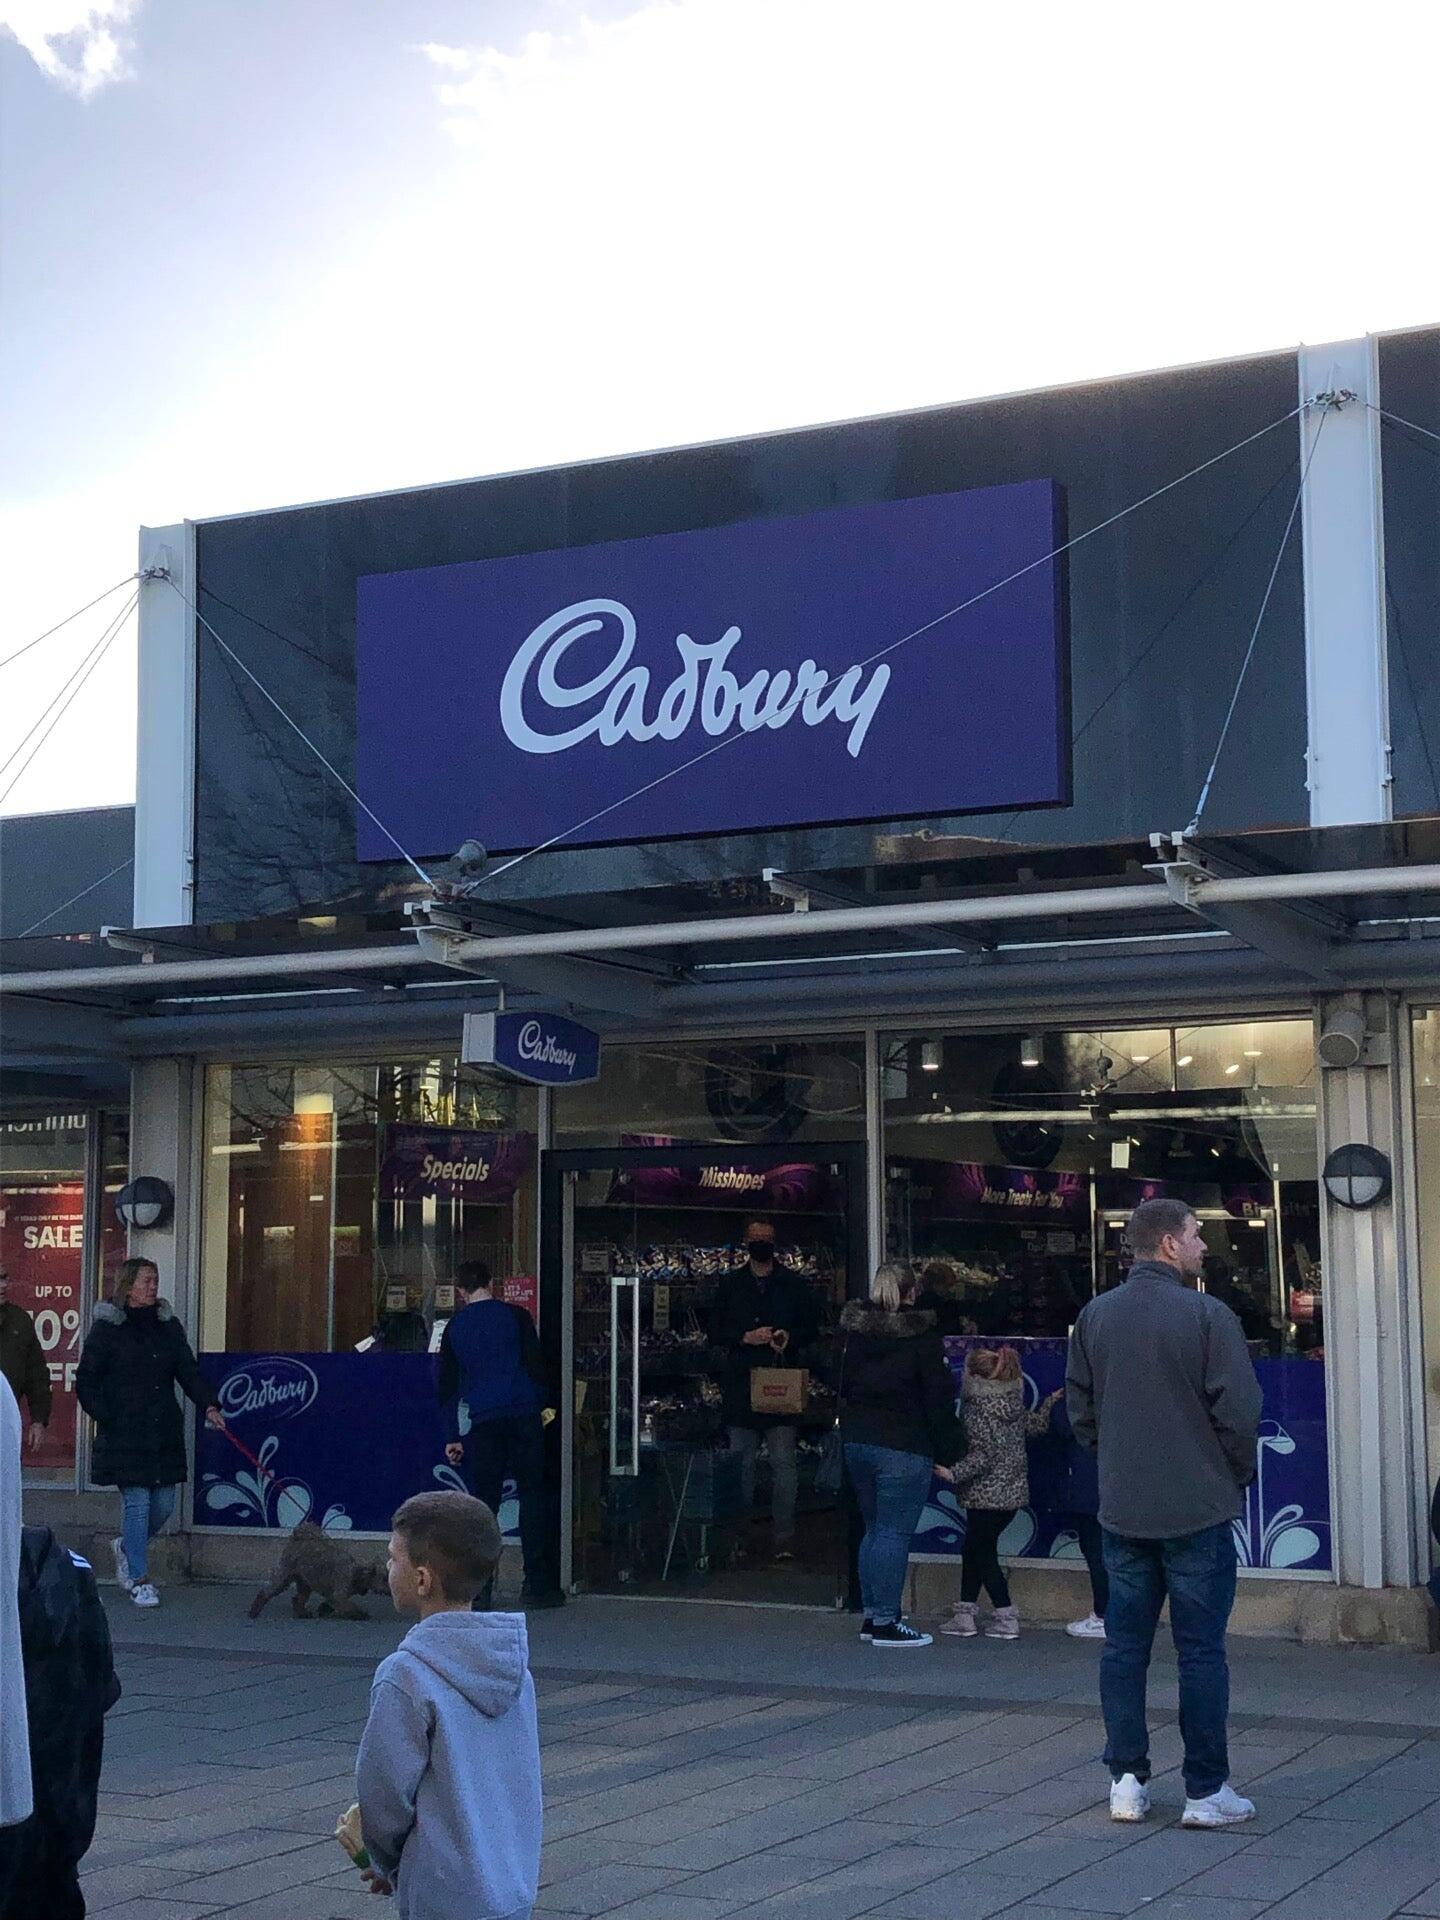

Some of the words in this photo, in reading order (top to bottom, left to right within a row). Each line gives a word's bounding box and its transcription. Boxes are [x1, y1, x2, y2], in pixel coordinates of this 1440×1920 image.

[500, 599, 890, 757] Cadbury
[518, 1020, 576, 1075] Cadbury
[420, 1154, 489, 1184] Specials
[699, 1166, 765, 1193] Misshapes
[24, 1225, 83, 1249] SALE
[35, 1286, 52, 1297] UP
[55, 1286, 72, 1297] TO
[26, 1310, 80, 1350] 0%
[218, 1373, 307, 1418] Cadbury
